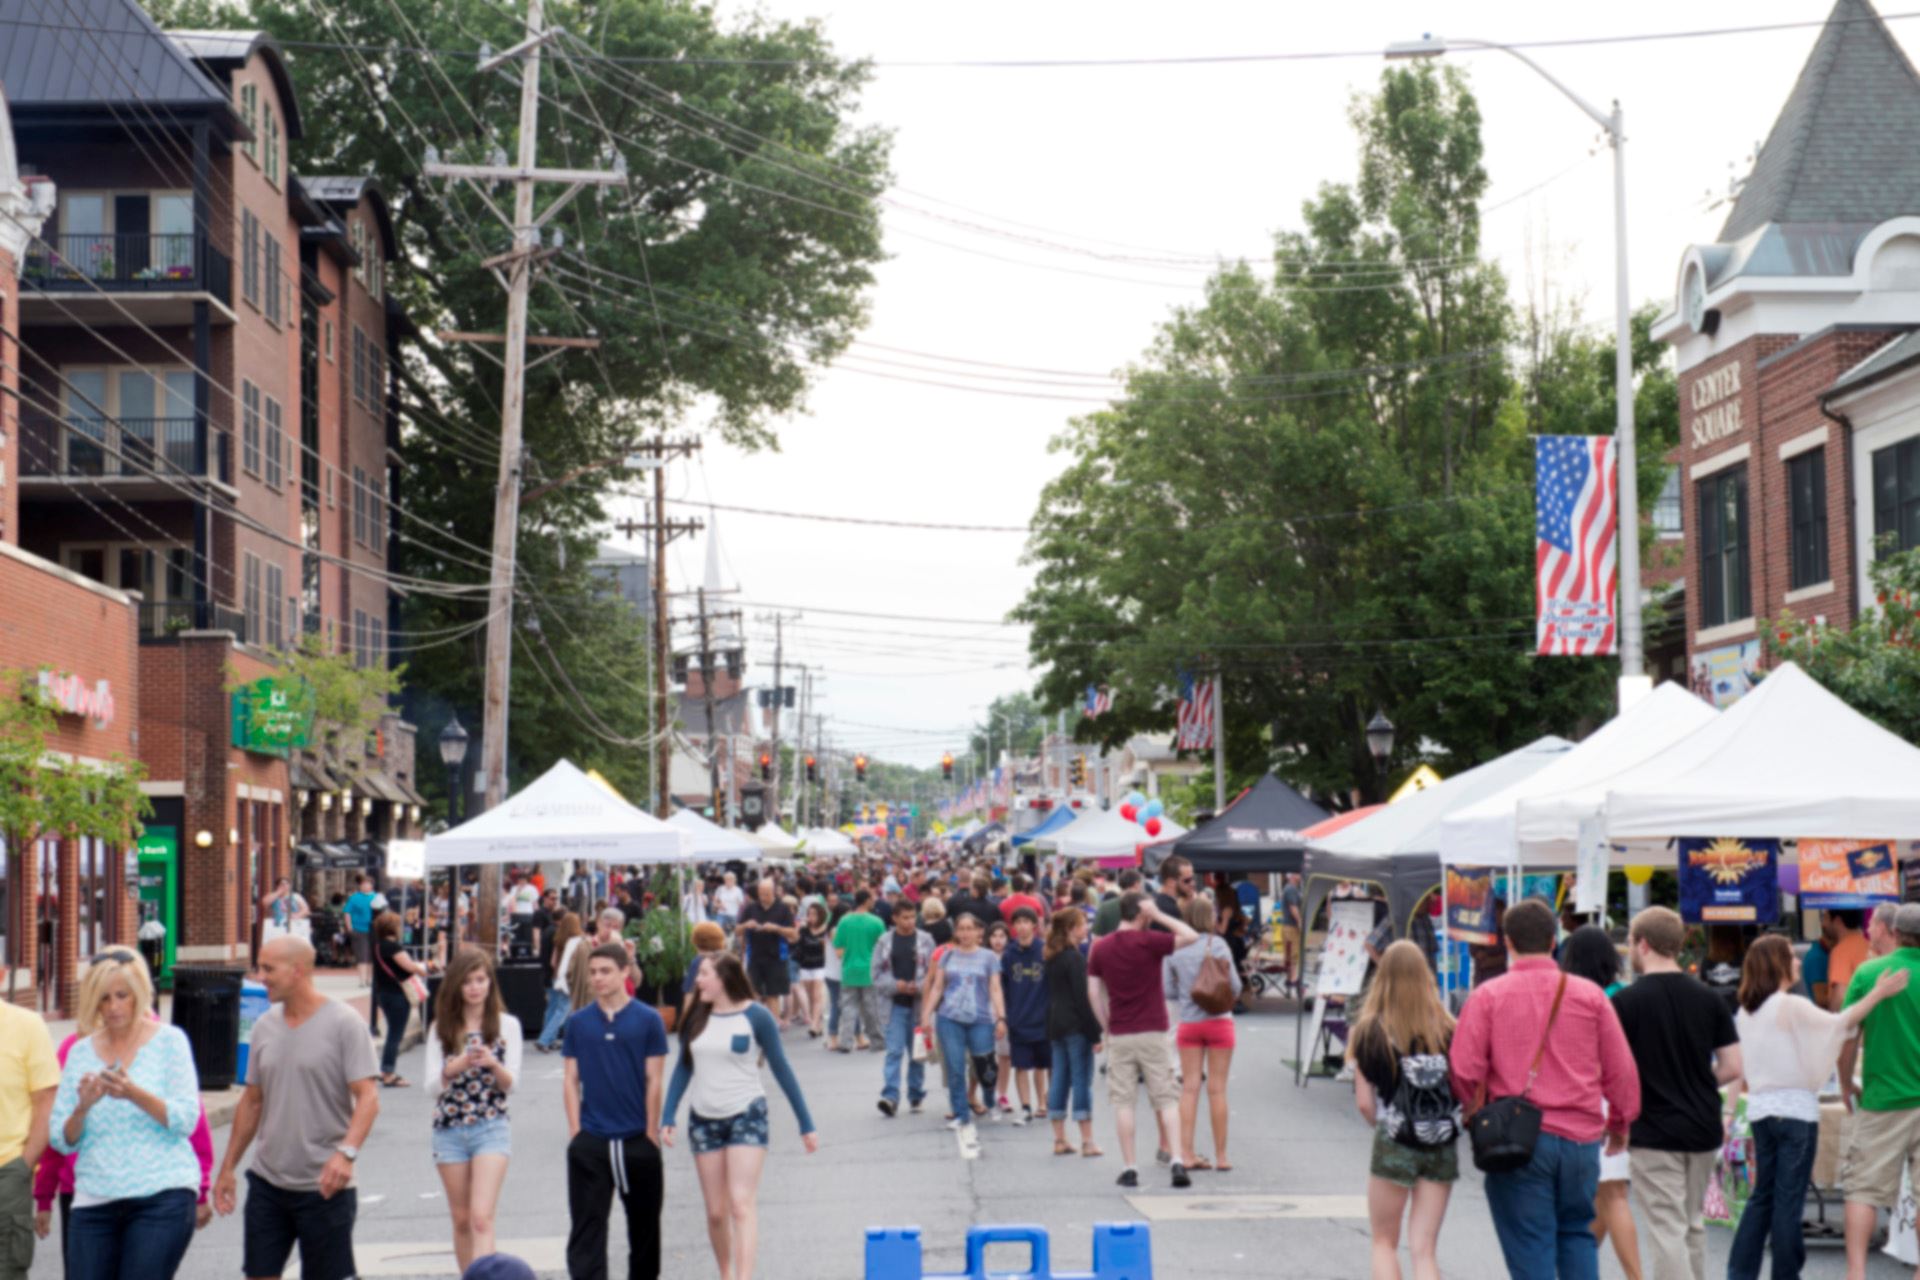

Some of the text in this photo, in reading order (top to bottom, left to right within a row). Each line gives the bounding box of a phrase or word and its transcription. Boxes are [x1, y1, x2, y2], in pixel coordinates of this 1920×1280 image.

[1692, 360, 1741, 411] CENTER
[1691, 398, 1743, 450] SQUARE
[1543, 611, 1611, 624] Downtown
[1556, 626, 1602, 638] Newark
[144, 845, 167, 854] Bank
